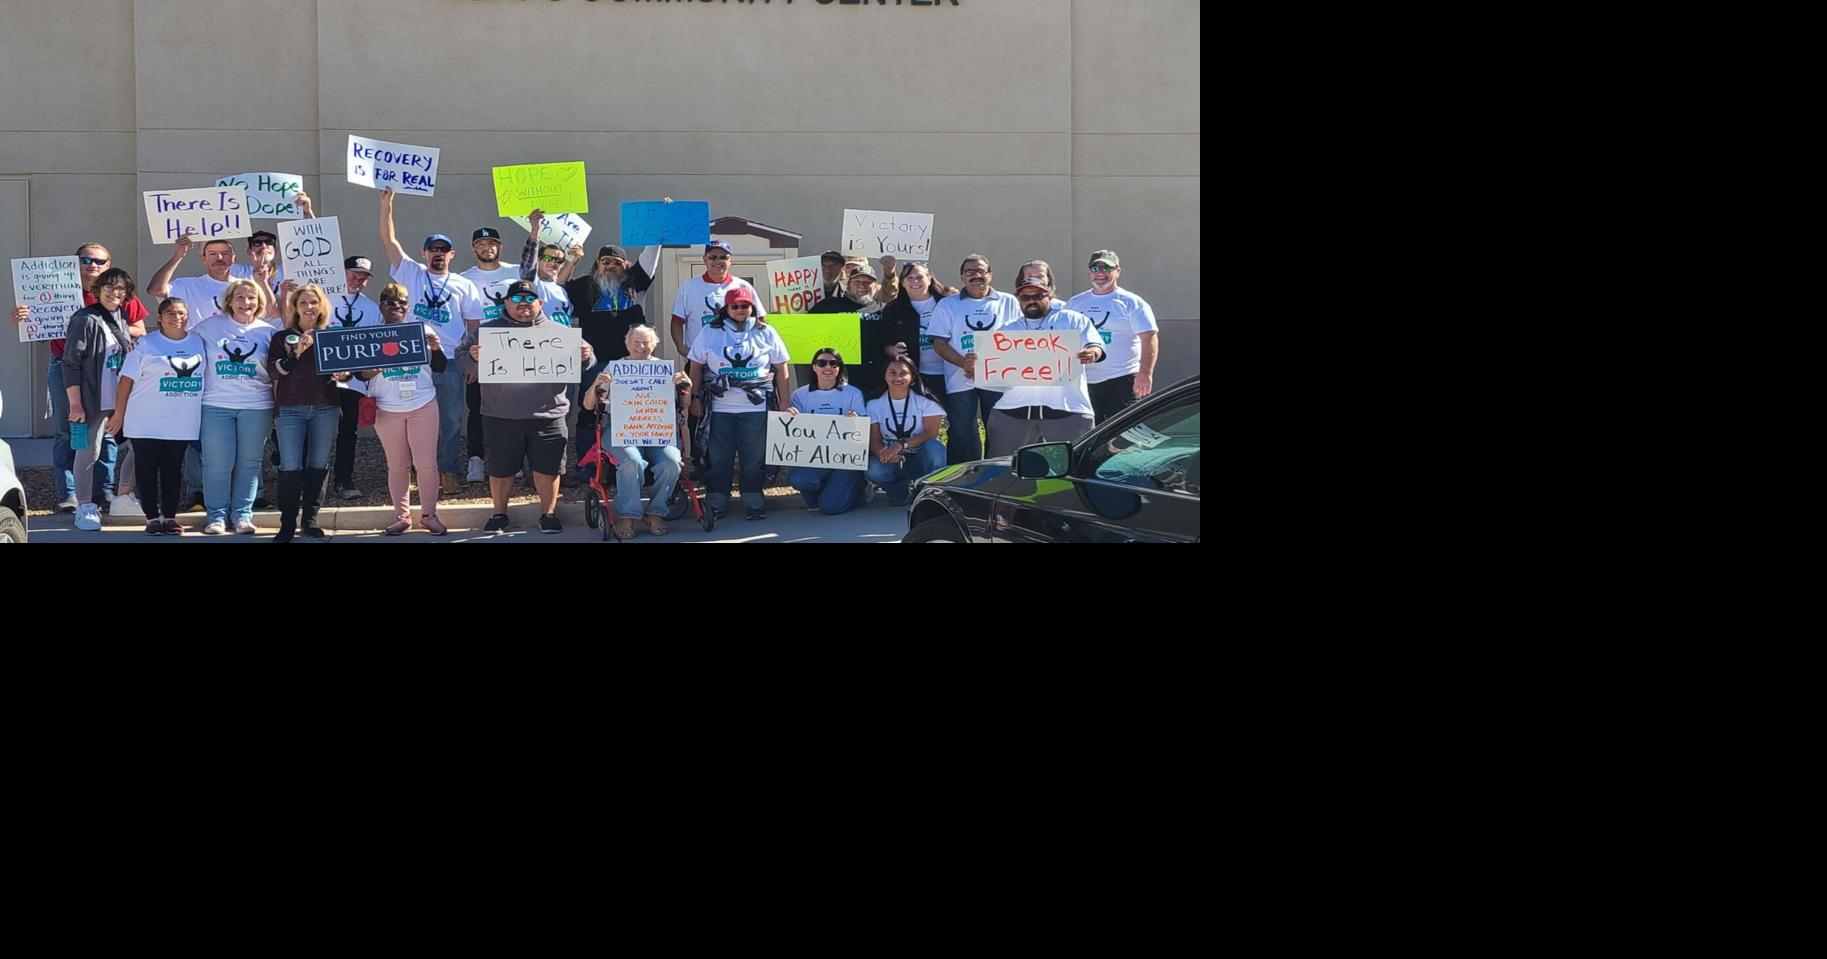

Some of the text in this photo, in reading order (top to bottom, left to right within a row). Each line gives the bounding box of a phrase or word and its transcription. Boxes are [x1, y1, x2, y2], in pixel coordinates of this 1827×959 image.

[353, 142, 432, 172] RECOVERY
[258, 175, 299, 198] Hope
[375, 168, 398, 182] FOR
[402, 171, 434, 188] REAL
[499, 167, 553, 185] HOPE
[150, 191, 240, 213] There Is
[167, 215, 241, 239] Help!!
[294, 223, 323, 236] WITH
[855, 214, 928, 240] Victory
[285, 237, 331, 260] GOD
[849, 234, 930, 256] is Yours!
[21, 260, 76, 271] Addiction
[295, 266, 336, 278] THINGS
[303, 260, 327, 268] ALL
[34, 273, 60, 281] giving
[774, 268, 818, 288] HAPPY
[775, 288, 822, 314] HOPE
[341, 330, 399, 341] FIND YOUR
[490, 331, 564, 349] There
[993, 332, 1068, 352] Break
[488, 356, 574, 378] Is Help!
[613, 363, 672, 376] ADDICTION
[984, 357, 1072, 382] Free!!
[779, 417, 862, 441] You Are
[771, 443, 867, 467] Not Alone!
